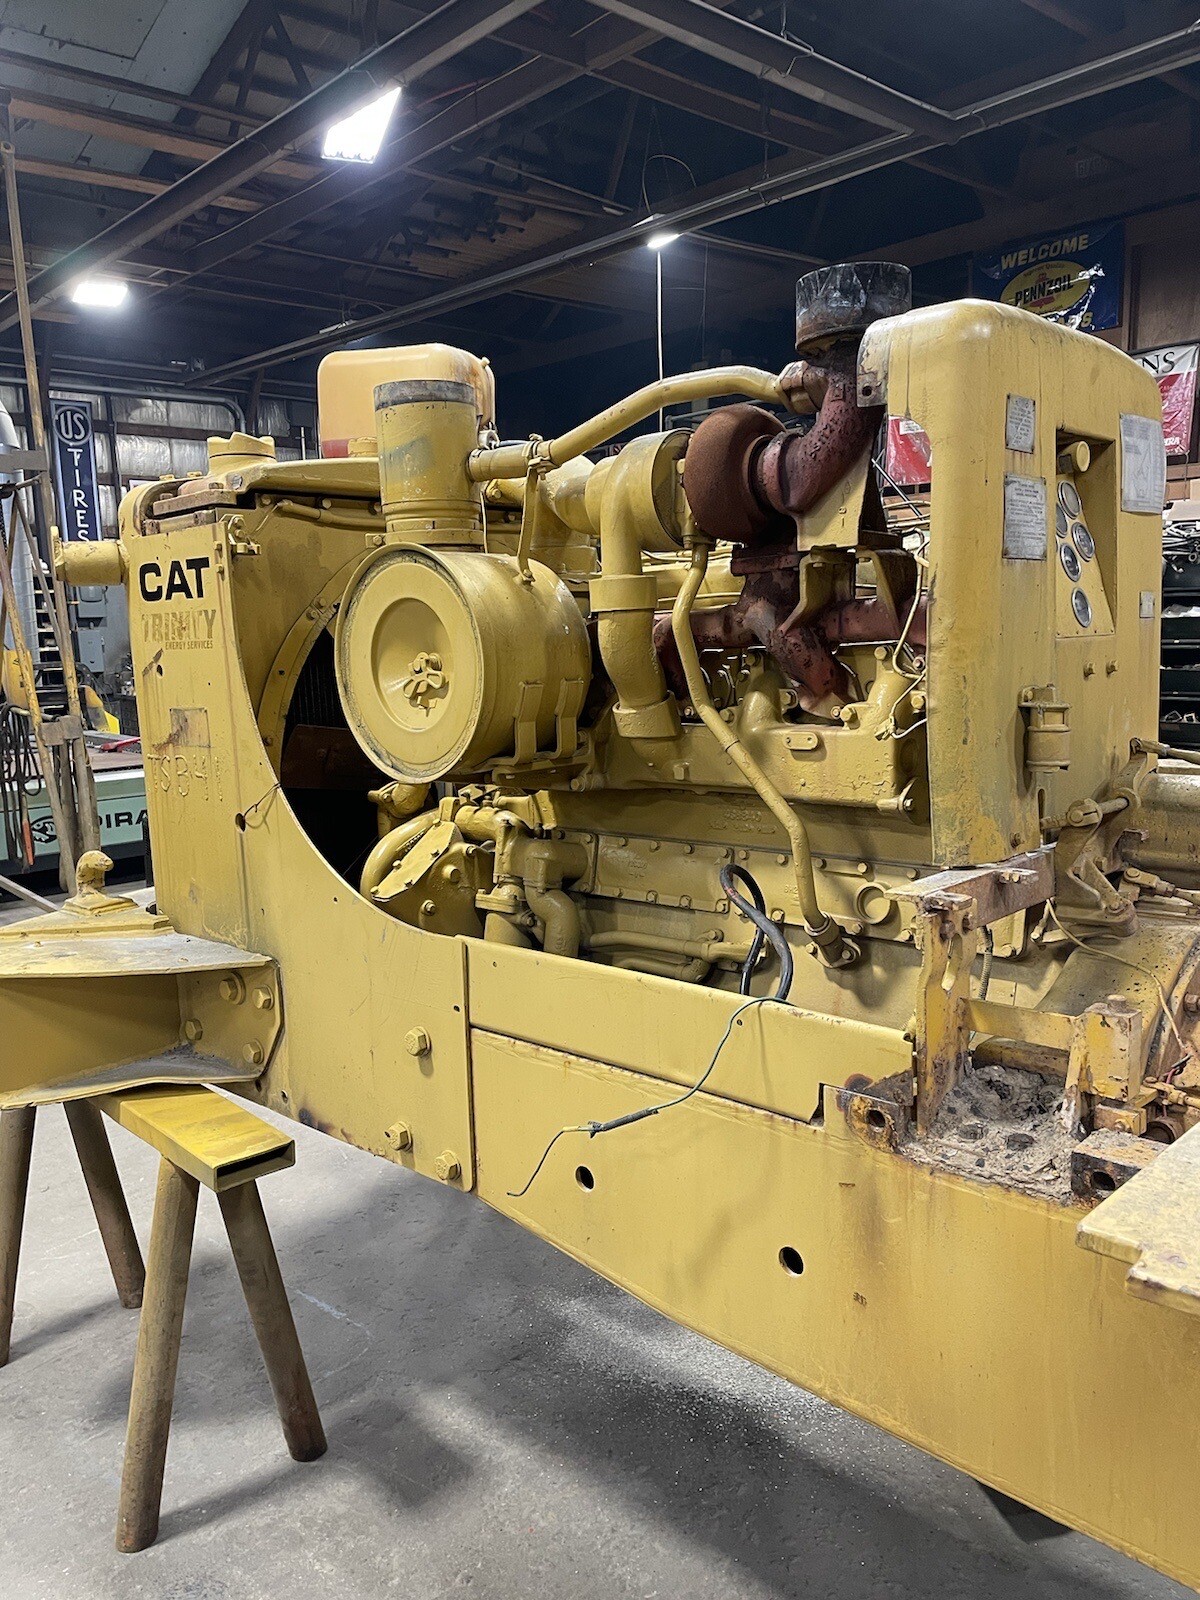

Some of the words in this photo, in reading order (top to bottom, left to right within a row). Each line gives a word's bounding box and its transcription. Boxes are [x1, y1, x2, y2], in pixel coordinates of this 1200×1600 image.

[1001, 234, 1089, 271] WELCOME
[1015, 274, 1074, 305] PENNZOIL
[60, 410, 86, 440] US
[67, 448, 90, 541] TIRES
[139, 557, 210, 602] CAT
[141, 609, 217, 642] TRINITY
[165, 641, 186, 650] ENERGY
[187, 640, 213, 649] SERVICES
